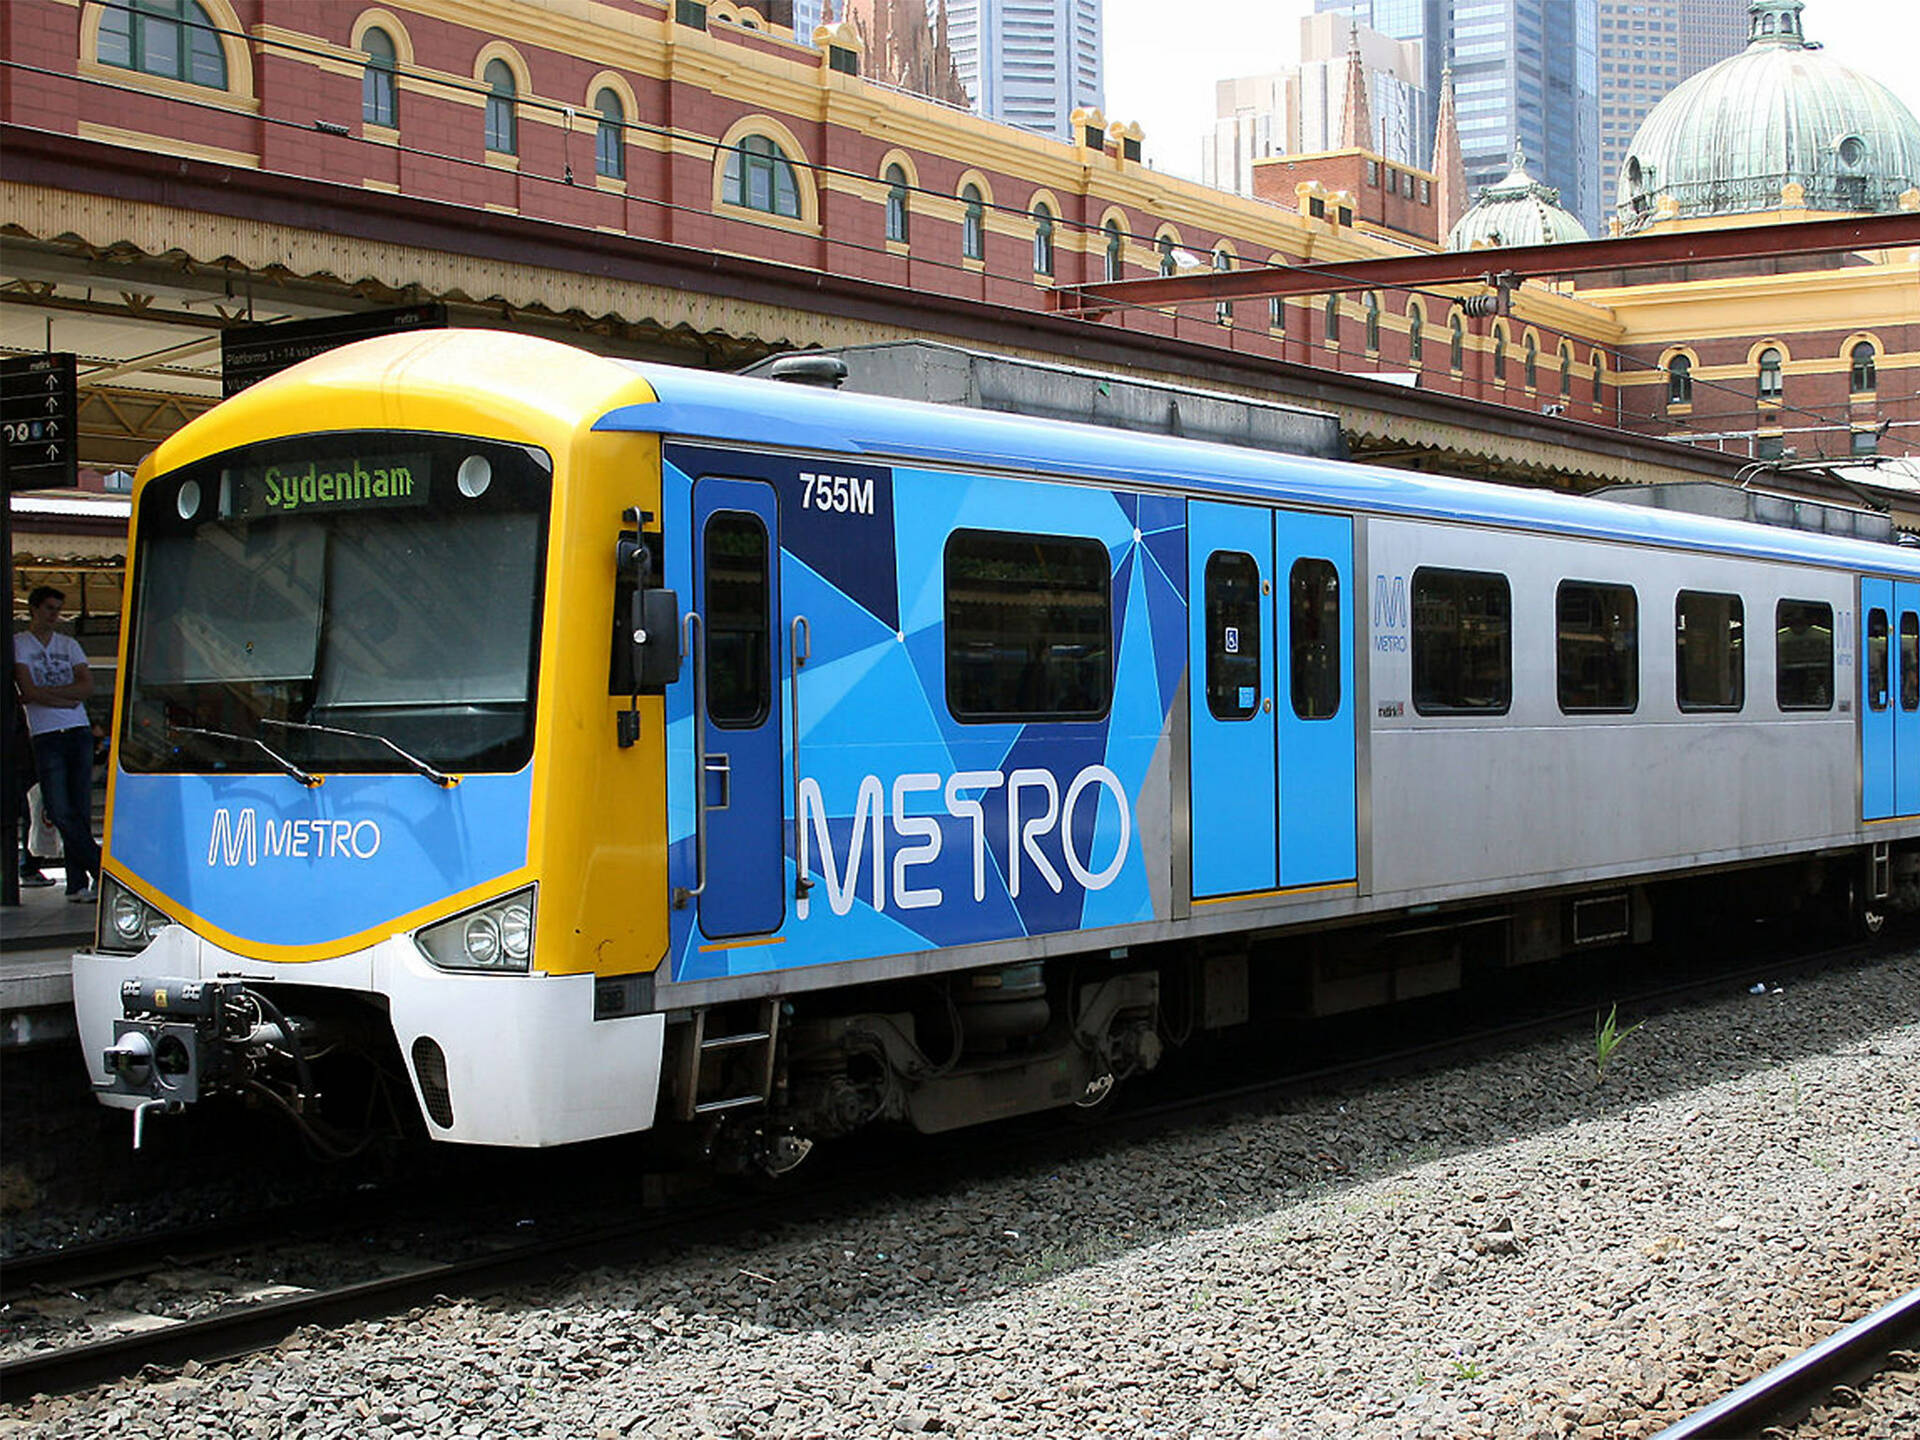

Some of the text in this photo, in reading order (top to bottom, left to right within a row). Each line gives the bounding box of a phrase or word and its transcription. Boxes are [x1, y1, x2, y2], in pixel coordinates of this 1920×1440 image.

[225, 349, 268, 366] Platforms
[269, 349, 275, 361] 1
[284, 346, 295, 360] 14
[265, 459, 412, 509] Sydenham
[799, 472, 874, 515] 755M
[1374, 635, 1408, 652] METRO
[264, 819, 381, 859] METRO
[796, 764, 1131, 921] METRO
